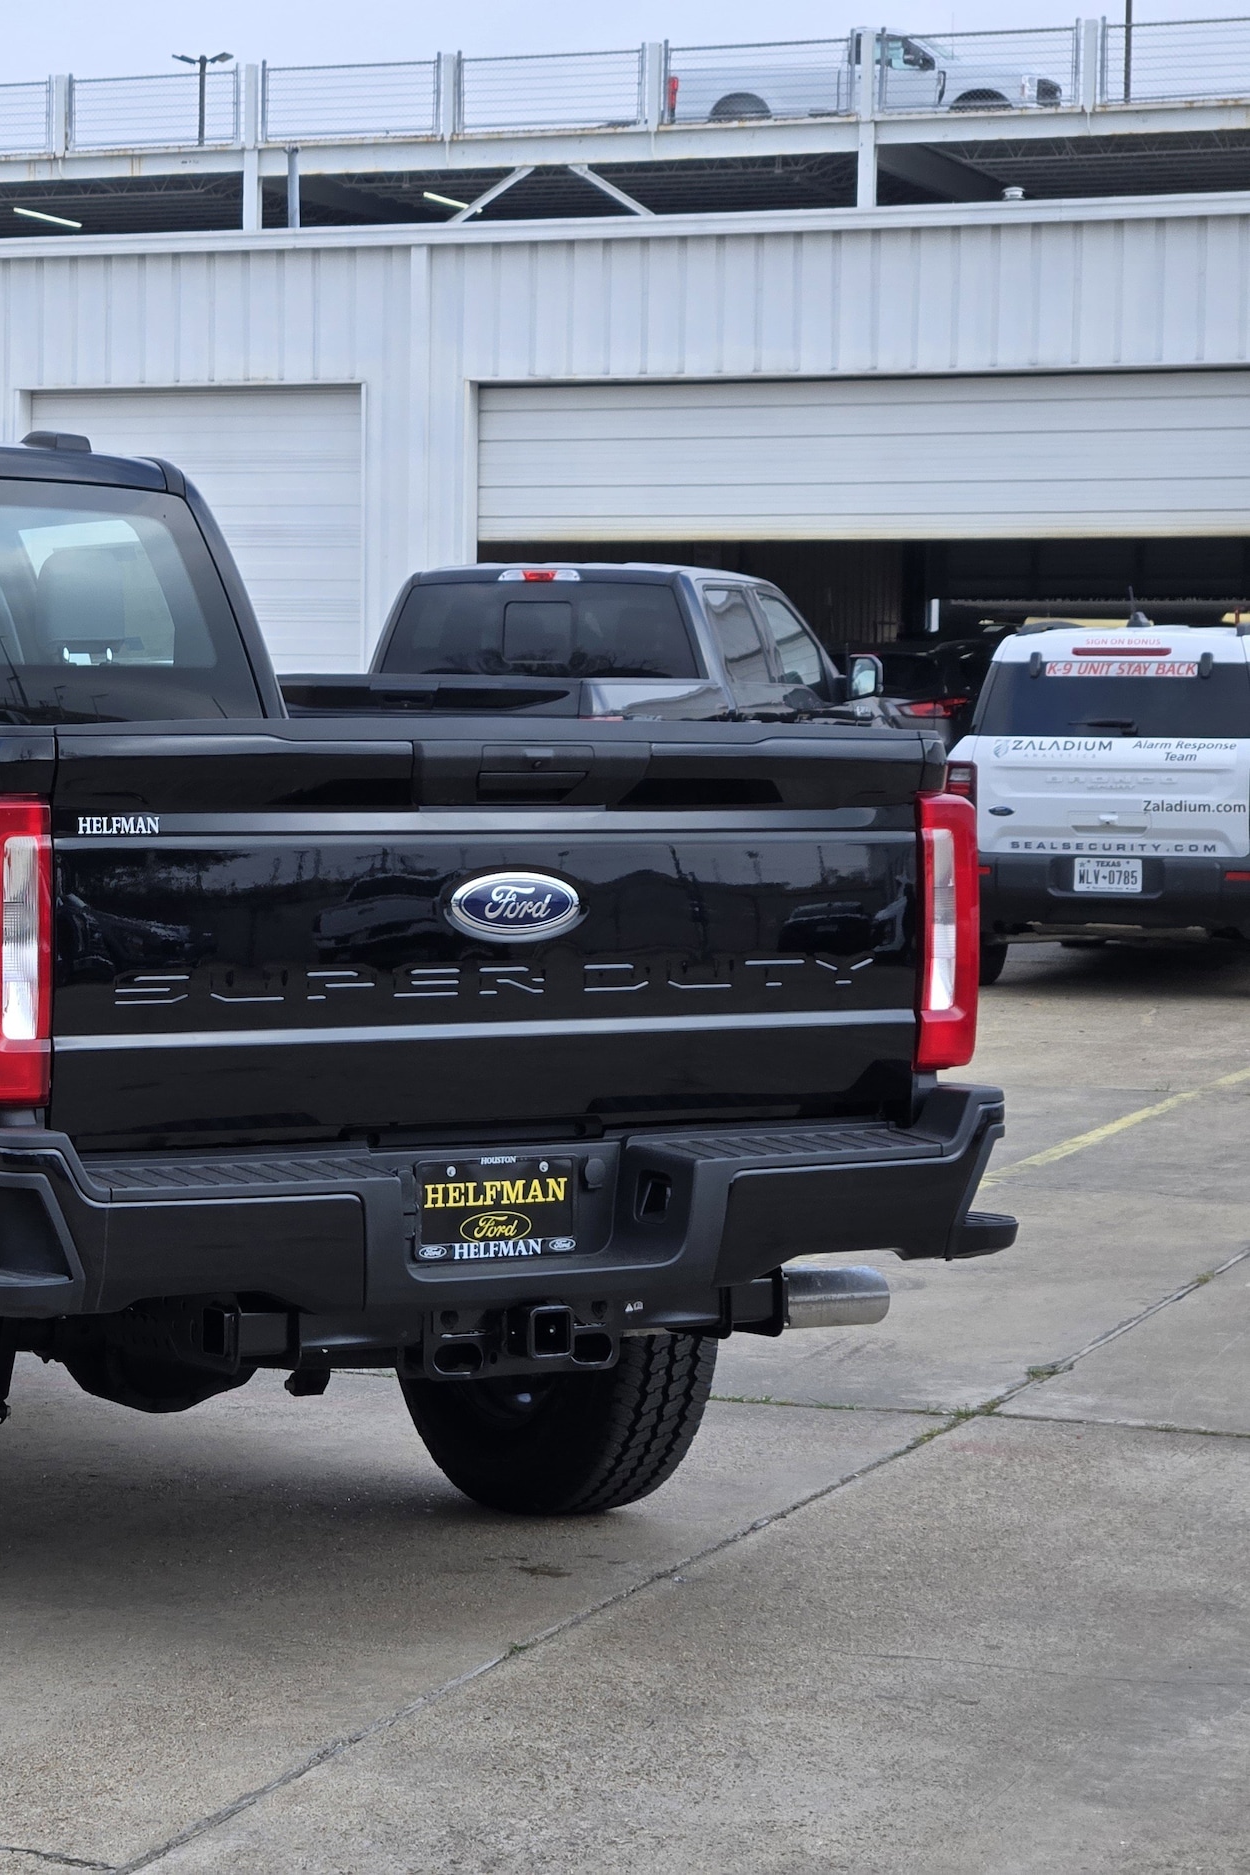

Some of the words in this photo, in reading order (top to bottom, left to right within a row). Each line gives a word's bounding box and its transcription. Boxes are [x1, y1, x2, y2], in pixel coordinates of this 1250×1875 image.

[1047, 663, 1073, 675] K-9
[1077, 663, 1111, 675] UNIT
[1116, 663, 1150, 675] STAY
[1155, 663, 1196, 675] BACK
[1012, 740, 1113, 751] ZALADIUM
[1132, 740, 1172, 751] Alarm
[1175, 740, 1237, 752] Response
[1164, 752, 1197, 762] Team
[1143, 800, 1246, 813] Zaladium.com
[77, 815, 160, 835] HELFMAN
[1011, 841, 1217, 853] SEALSECURITY.COM
[483, 884, 553, 924] Ford
[114, 962, 546, 1006] SUPER
[584, 955, 875, 993] DUTY
[480, 1156, 517, 1165] HOUSTON
[424, 1177, 568, 1209] HELFMAN
[473, 1214, 518, 1238] Ford
[453, 1238, 543, 1260] HELFMAN
